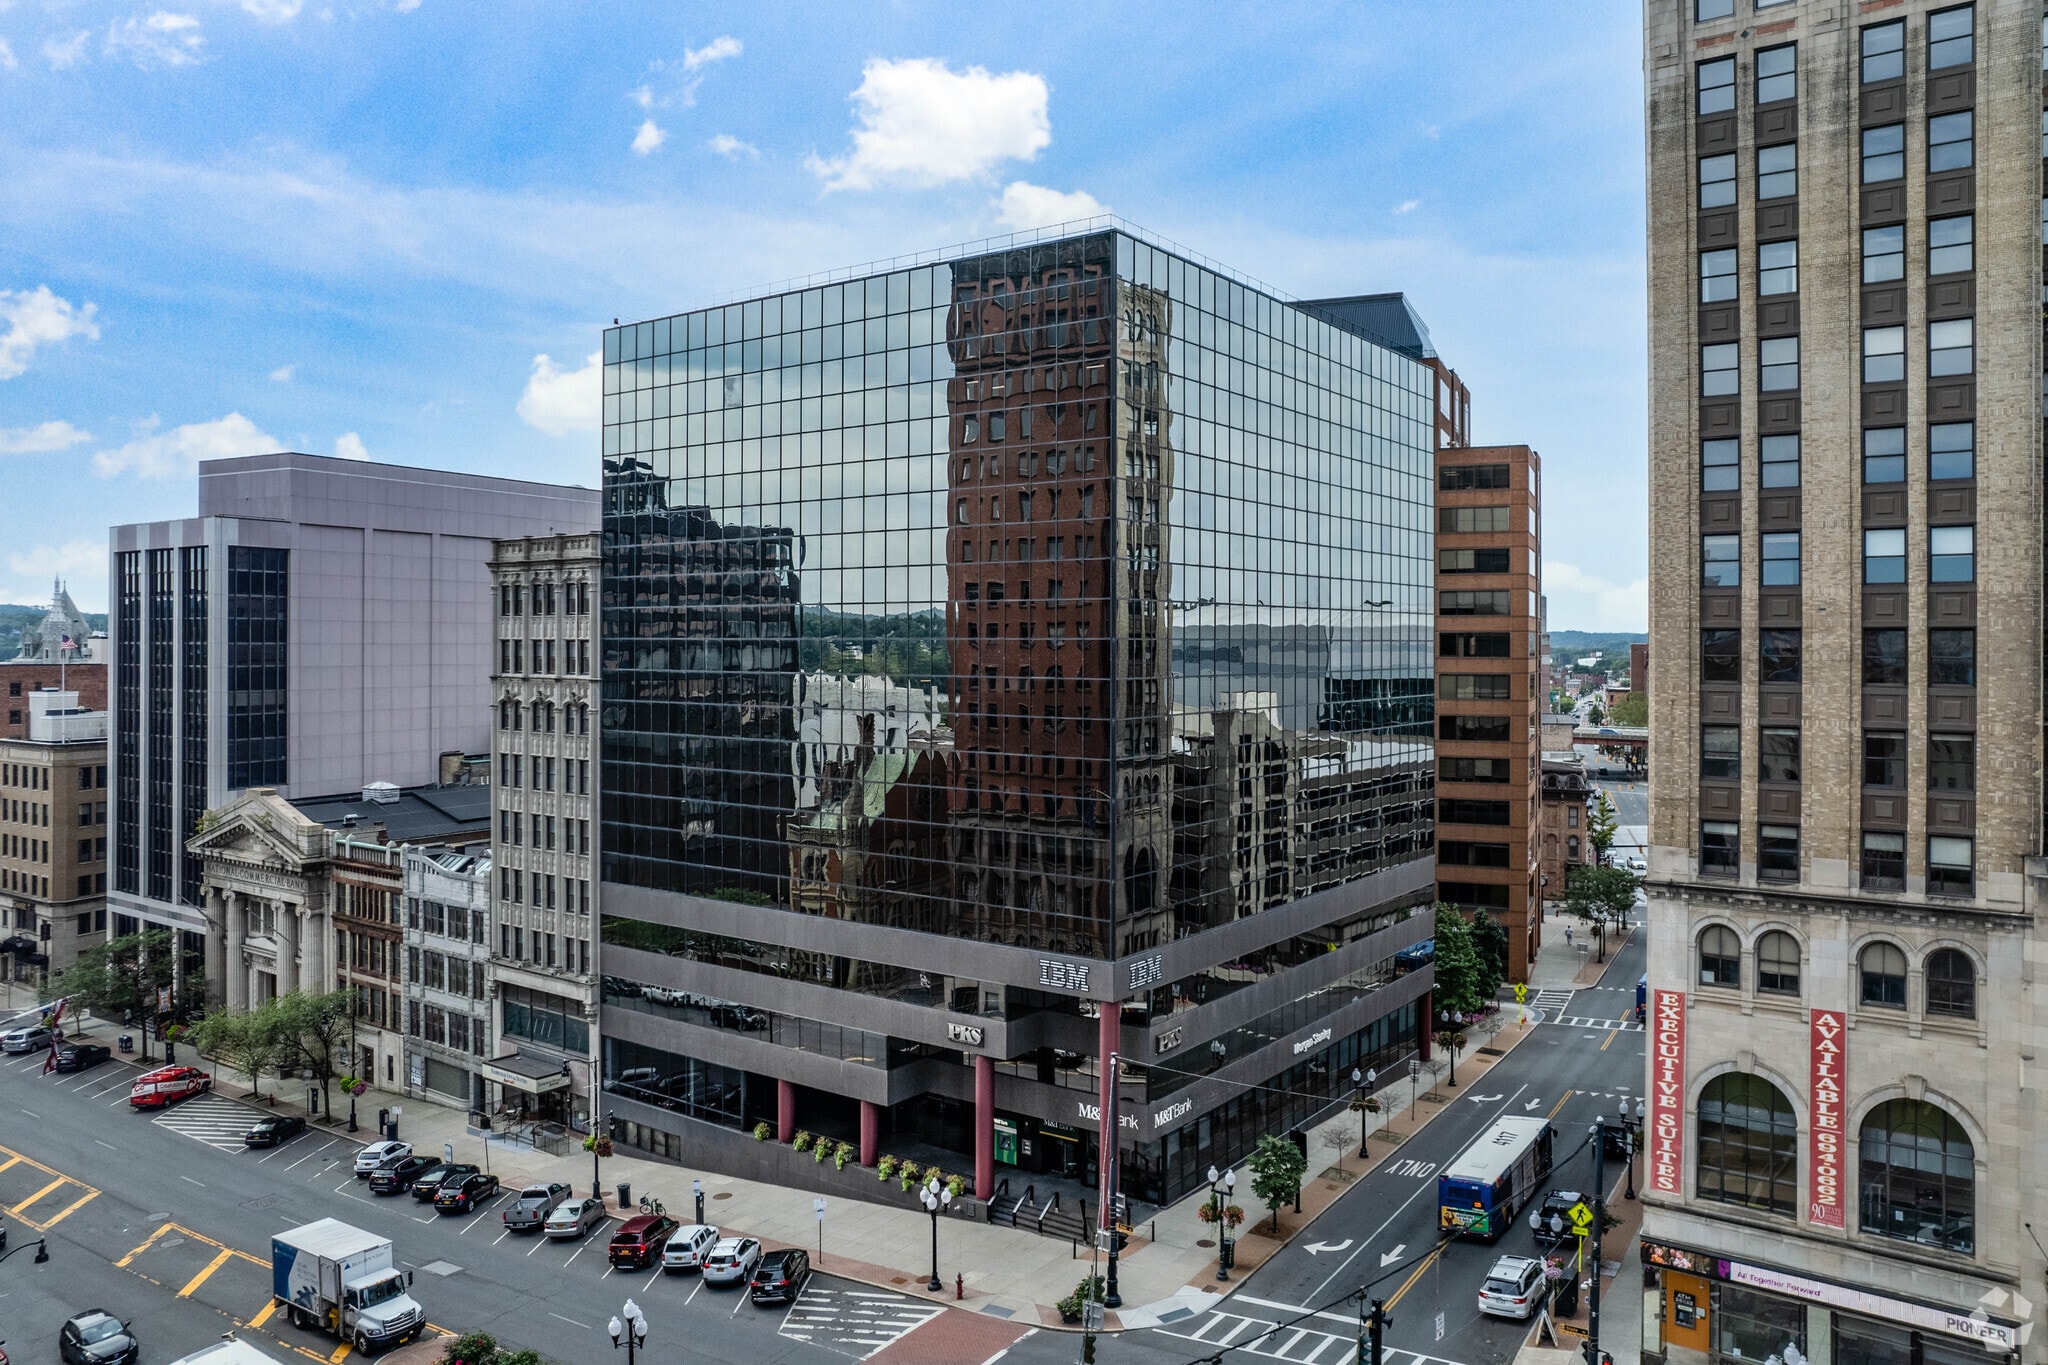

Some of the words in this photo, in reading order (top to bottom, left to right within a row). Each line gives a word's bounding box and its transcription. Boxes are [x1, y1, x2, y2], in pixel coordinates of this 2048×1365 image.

[206, 862, 239, 878] NATIONAL
[240, 868, 286, 887] COMMERCIAL
[286, 879, 305, 890] BANK
[1039, 959, 1089, 992] IBM
[1129, 954, 1162, 990] IBM
[948, 1022, 982, 1045] PKS
[1293, 1037, 1314, 1055] Morgan
[1312, 1028, 1332, 1045] Stanley
[1657, 992, 1681, 1109] EXECUTIVE
[1815, 1013, 1841, 1129] AVAILABLE
[1078, 1102, 1100, 1121] M&
[1119, 1114, 1139, 1130] ank
[1153, 1105, 1175, 1129] M&T
[1173, 1097, 1193, 1119] Bank
[1492, 1131, 1518, 1146] 4117
[1656, 1113, 1678, 1190] SUITES
[1384, 1158, 1437, 1178] ONLY
[1817, 1133, 1838, 1206] 694-0662
[1812, 1203, 1825, 1219] 90
[1677, 1292, 1692, 1300] ATM
[1749, 1273, 1784, 1288] Together
[1786, 1282, 1821, 1297] Forward
[1946, 1317, 2008, 1343] PIONEER
